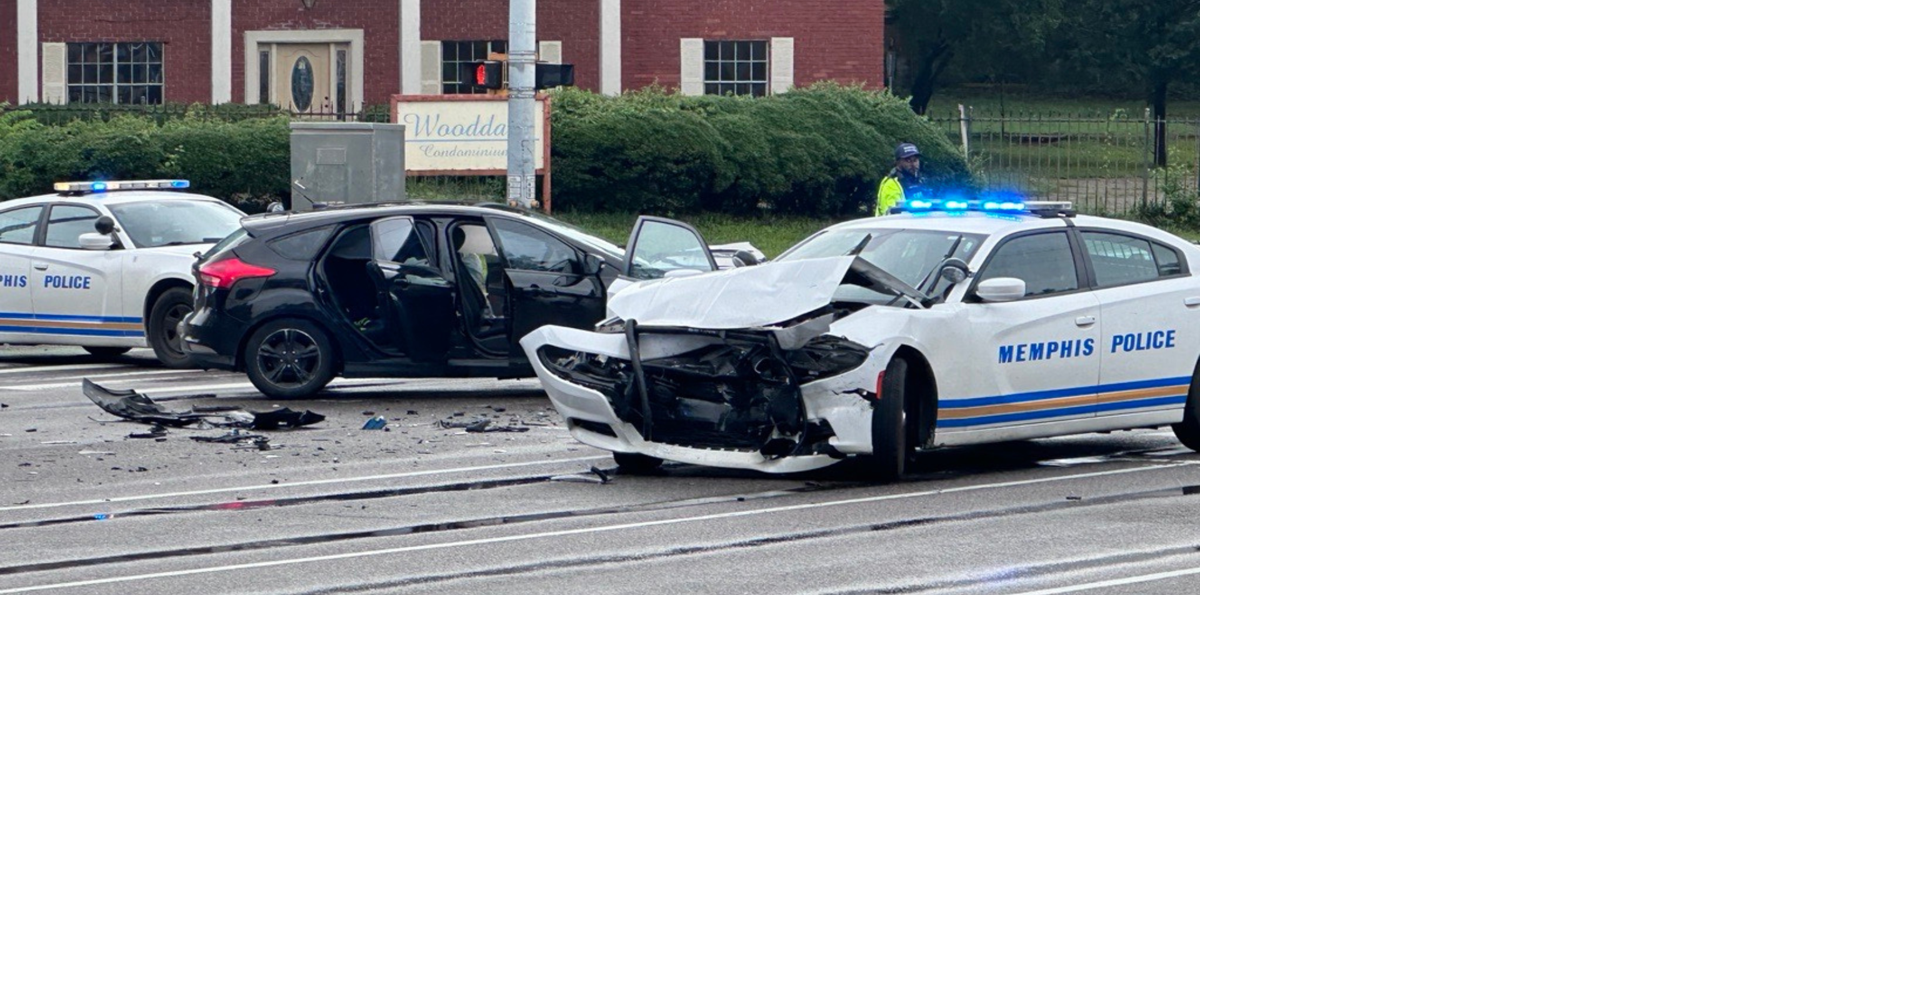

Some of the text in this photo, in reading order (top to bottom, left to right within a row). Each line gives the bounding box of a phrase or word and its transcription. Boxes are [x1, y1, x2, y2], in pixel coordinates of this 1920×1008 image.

[403, 113, 507, 137] Woodda
[44, 275, 91, 289] POLICE
[998, 330, 1176, 364] MEMPHIS POLICE
